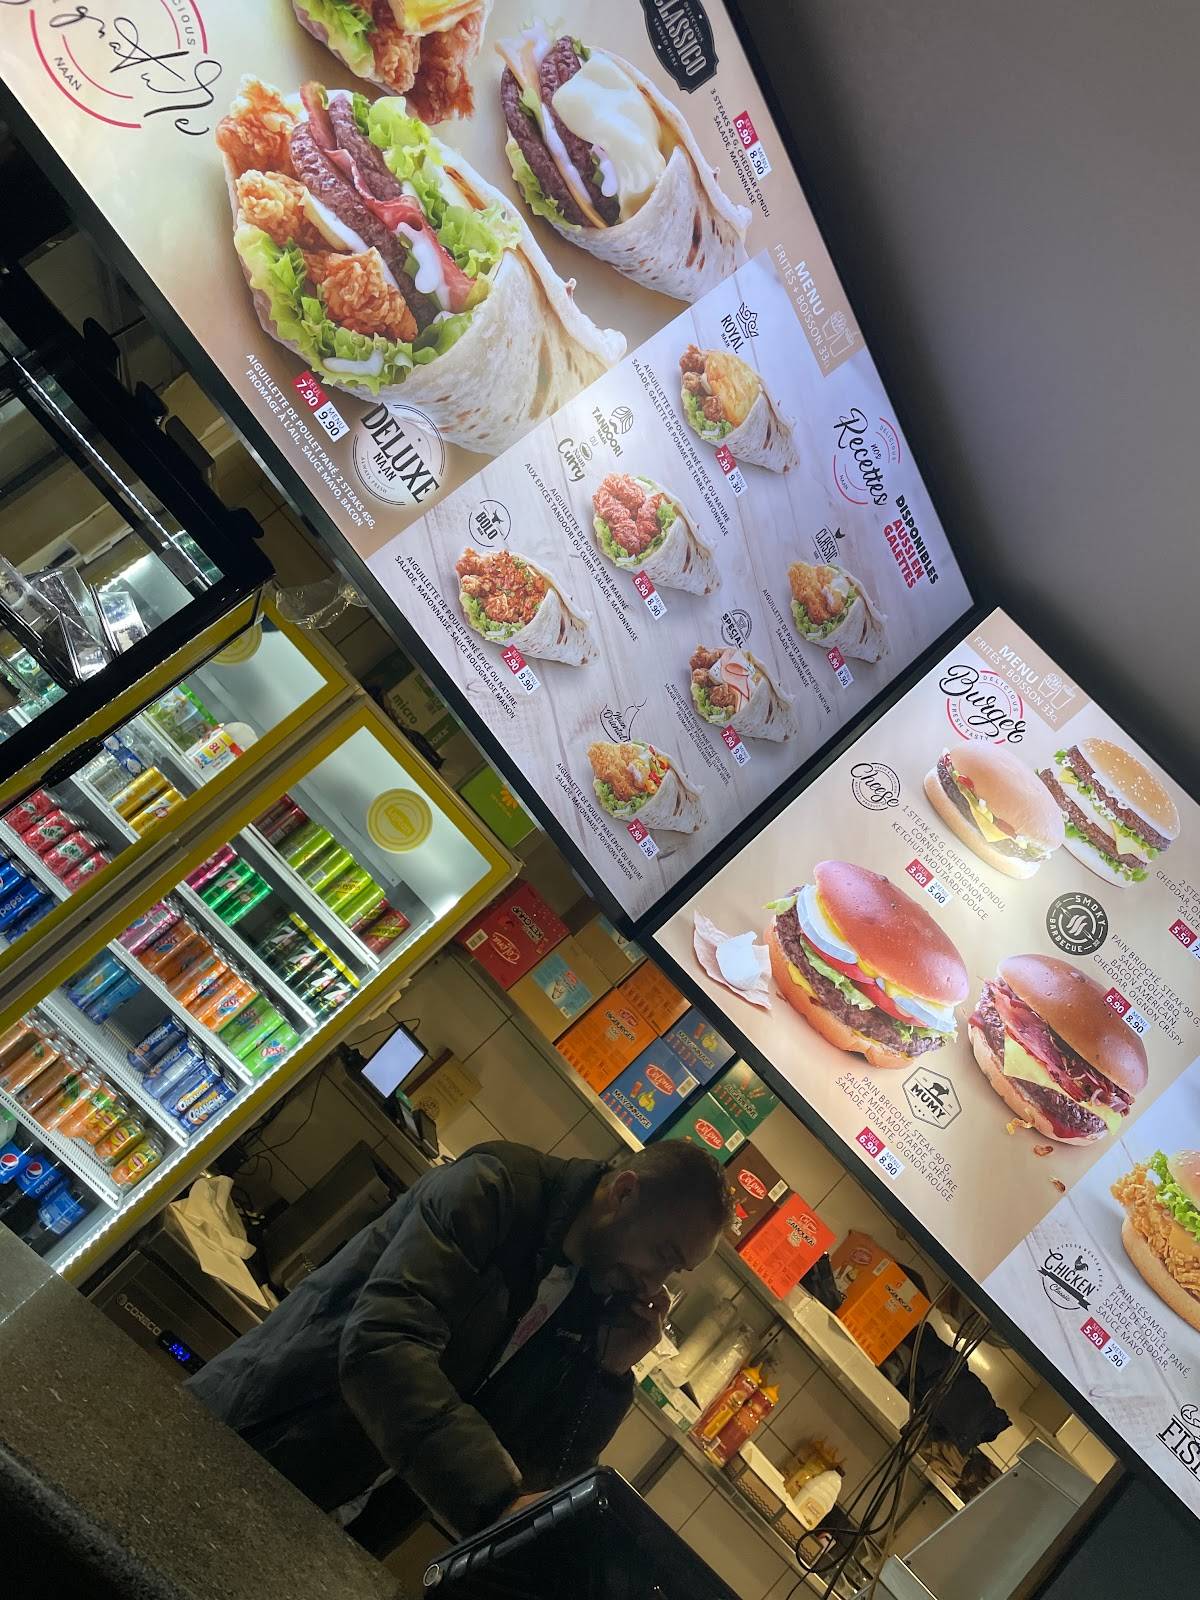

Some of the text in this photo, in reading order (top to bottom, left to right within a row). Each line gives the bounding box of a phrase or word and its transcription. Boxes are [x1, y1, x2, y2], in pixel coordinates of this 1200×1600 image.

[51, 54, 83, 92] NAAN
[734, 119, 752, 145] 6.90
[712, 95, 730, 126] STEAKS
[726, 127, 735, 138] 45
[736, 149, 757, 187] CHEDDAR
[753, 188, 770, 217] FONDU
[712, 115, 756, 205] SALADE, MAYONNAISE
[748, 150, 765, 175] 8.90
[793, 260, 825, 316] MENU
[719, 313, 746, 353] ROYAL
[294, 378, 320, 407] 7.90
[244, 352, 289, 409] AIGUILLETTE
[285, 407, 298, 422] DE
[294, 419, 321, 453] POULET
[317, 451, 339, 478] PANÉ,
[339, 481, 364, 512] STEAKS
[316, 410, 340, 437] 9.90
[325, 406, 346, 429] MENU
[590, 406, 624, 457] TANDOORI
[244, 368, 281, 414] FROMAGE
[300, 444, 324, 473] SAUCE
[320, 471, 344, 499] MAYO,
[339, 497, 364, 527] BACON
[359, 401, 441, 504] DELUXE
[557, 437, 585, 481] Curry
[630, 358, 729, 536] SALADE, GALETTE DE POMME DE TERRE, MAYONNAISE
[642, 363, 671, 409] AIGUILLETTE
[666, 409, 677, 421] DE
[672, 419, 691, 447] POULET
[706, 484, 717, 496] OU
[712, 495, 731, 523] NATURE
[833, 407, 888, 507] Recettes
[869, 443, 883, 460] nos
[372, 452, 397, 481] NAAN
[714, 450, 731, 472] 7.30
[726, 473, 742, 493] 9.30
[474, 511, 499, 540] BOLO
[548, 487, 580, 531] AIGUILLETTE
[575, 530, 586, 541] DE
[581, 540, 602, 567] POULET
[893, 494, 940, 584] DISPONIBLES
[523, 462, 537, 479] AUX
[548, 502, 576, 540] TANDOORI
[571, 538, 582, 551] OU
[609, 599, 639, 642] MAYONNAISE
[813, 528, 839, 563] CLASSIC
[881, 524, 917, 589] GALETTES
[892, 518, 925, 579] AUSSI EN
[632, 576, 649, 596] 6.90
[405, 555, 440, 600] AIGUILLETTE
[437, 598, 448, 610] DE
[444, 609, 466, 636] POULET
[462, 634, 479, 653] PANÉ
[488, 670, 500, 682] OU
[646, 598, 661, 616] 8.90
[721, 613, 745, 648] SPECIAL
[502, 651, 520, 671] 7.90
[997, 644, 1039, 684] MENU
[517, 672, 534, 691] 9.90
[392, 694, 418, 725] micro
[939, 664, 1026, 745] Burger
[721, 730, 735, 747] 7.90
[732, 748, 744, 764] 9.90
[851, 762, 899, 806] Cheese
[628, 823, 642, 841] 7.90
[640, 841, 653, 857] 9.90
[907, 865, 926, 885] 3.00
[922, 853, 964, 895] MOUTARDE
[960, 893, 988, 921] DOUCE
[952, 871, 984, 903] OIGNON
[0, 892, 25, 919] pepsi
[926, 884, 946, 904] 5.00
[1075, 895, 1105, 924] SMOKY
[510, 904, 545, 939] KETCHUP
[1176, 905, 1200, 930] SAUCE
[1049, 918, 1081, 952] BARBECUE
[1171, 925, 1191, 945] 5.50
[1109, 959, 1137, 986] BACON
[1092, 953, 1184, 1047] CHEDDAR, OIGNON CRISPY
[1105, 994, 1125, 1014] 6.90
[1124, 1014, 1144, 1034] 8.90
[612, 1088, 651, 1129] MAYONNAISE
[843, 1072, 870, 1100] SAUCE
[866, 1097, 887, 1117] MIEL
[909, 1083, 945, 1120] MUMY
[860, 1075, 881, 1096] PAIN
[910, 1129, 935, 1154] STEAK
[932, 1152, 945, 1165] 90
[834, 1076, 953, 1202] SALADE, TOMATE, OIGNON ROUGE
[858, 1134, 878, 1155] 6.90
[877, 1155, 898, 1176] 8.90
[884, 1151, 901, 1169] MENU
[1044, 1249, 1096, 1296] CHICKEN
[1115, 1283, 1135, 1304] PAIN
[124, 1302, 162, 1336] CORECO
[1083, 1324, 1104, 1346] 5.90
[1095, 1305, 1144, 1356] SAUCE MAYO
[1108, 1291, 1130, 1313] FILET
[1128, 1312, 1141, 1325] DE
[1139, 1323, 1169, 1355] POULET
[1103, 1346, 1123, 1368] 7.90
